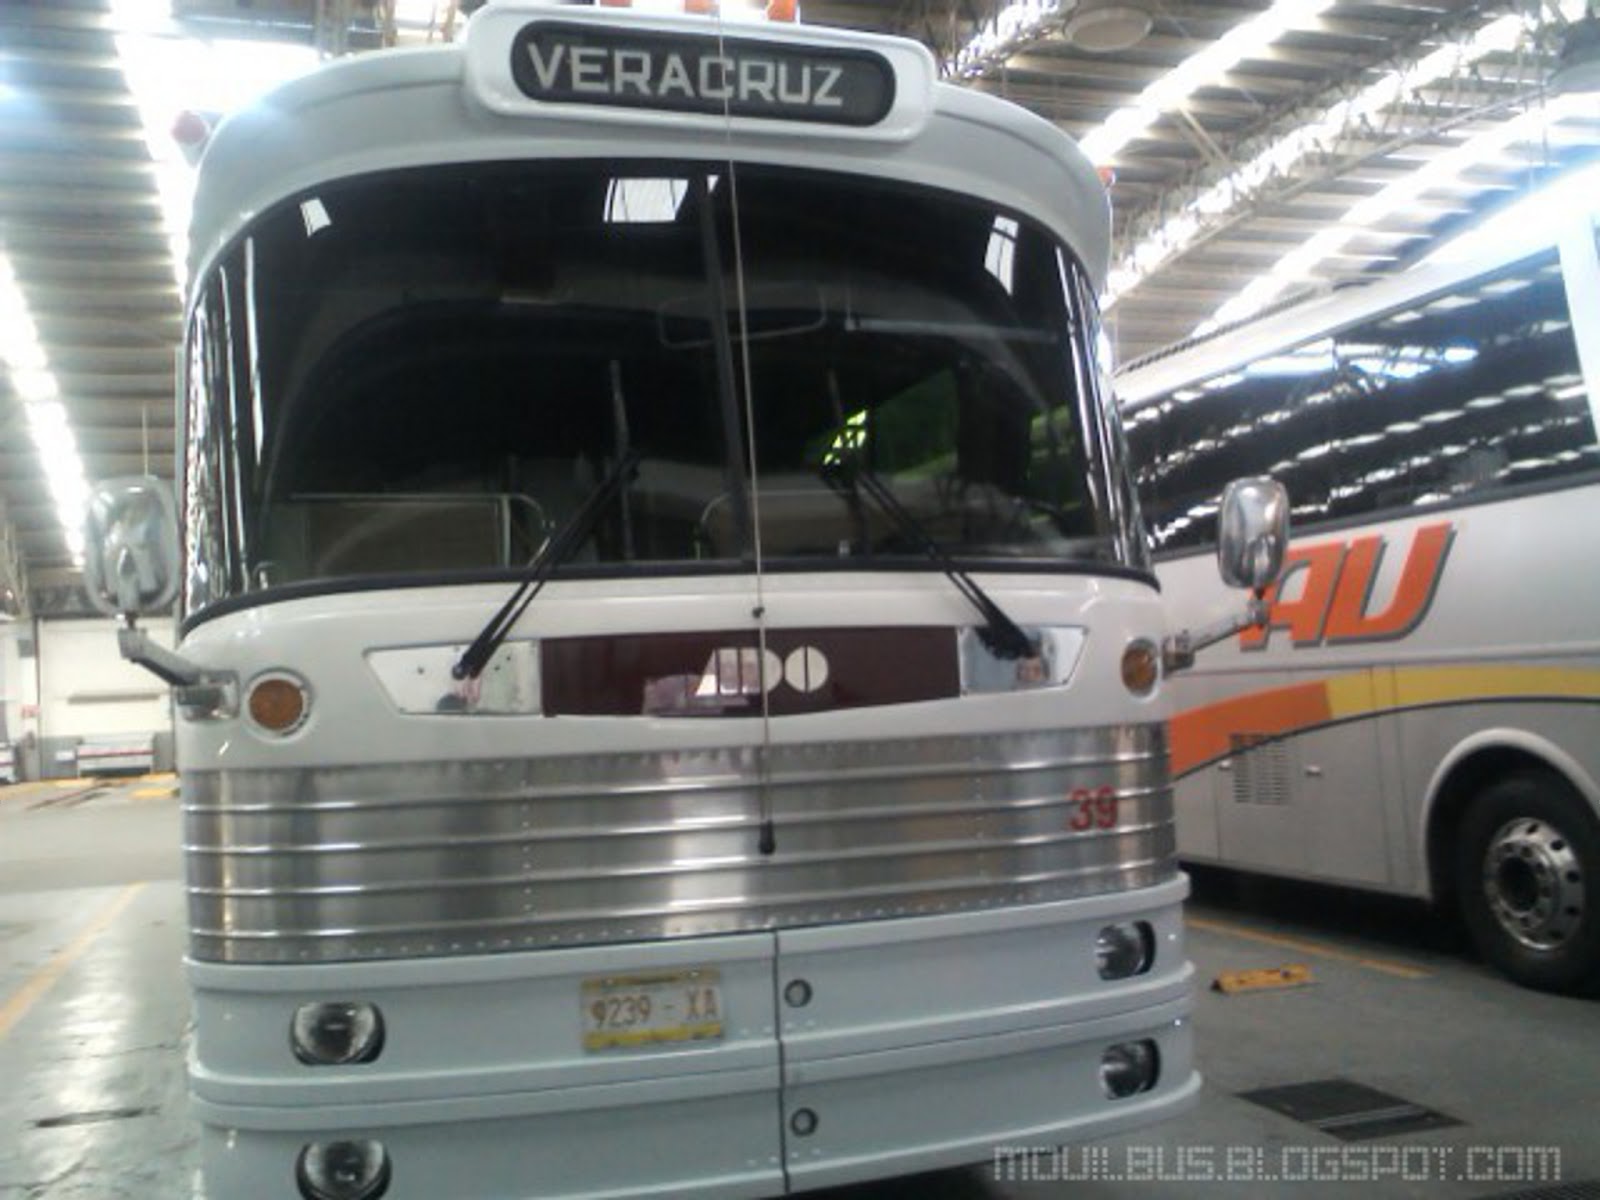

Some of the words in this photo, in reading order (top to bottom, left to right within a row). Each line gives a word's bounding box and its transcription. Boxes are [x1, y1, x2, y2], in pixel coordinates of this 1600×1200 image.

[527, 42, 844, 107] VERACRUZ
[1238, 521, 1457, 652] AU
[1070, 786, 1119, 831] 39
